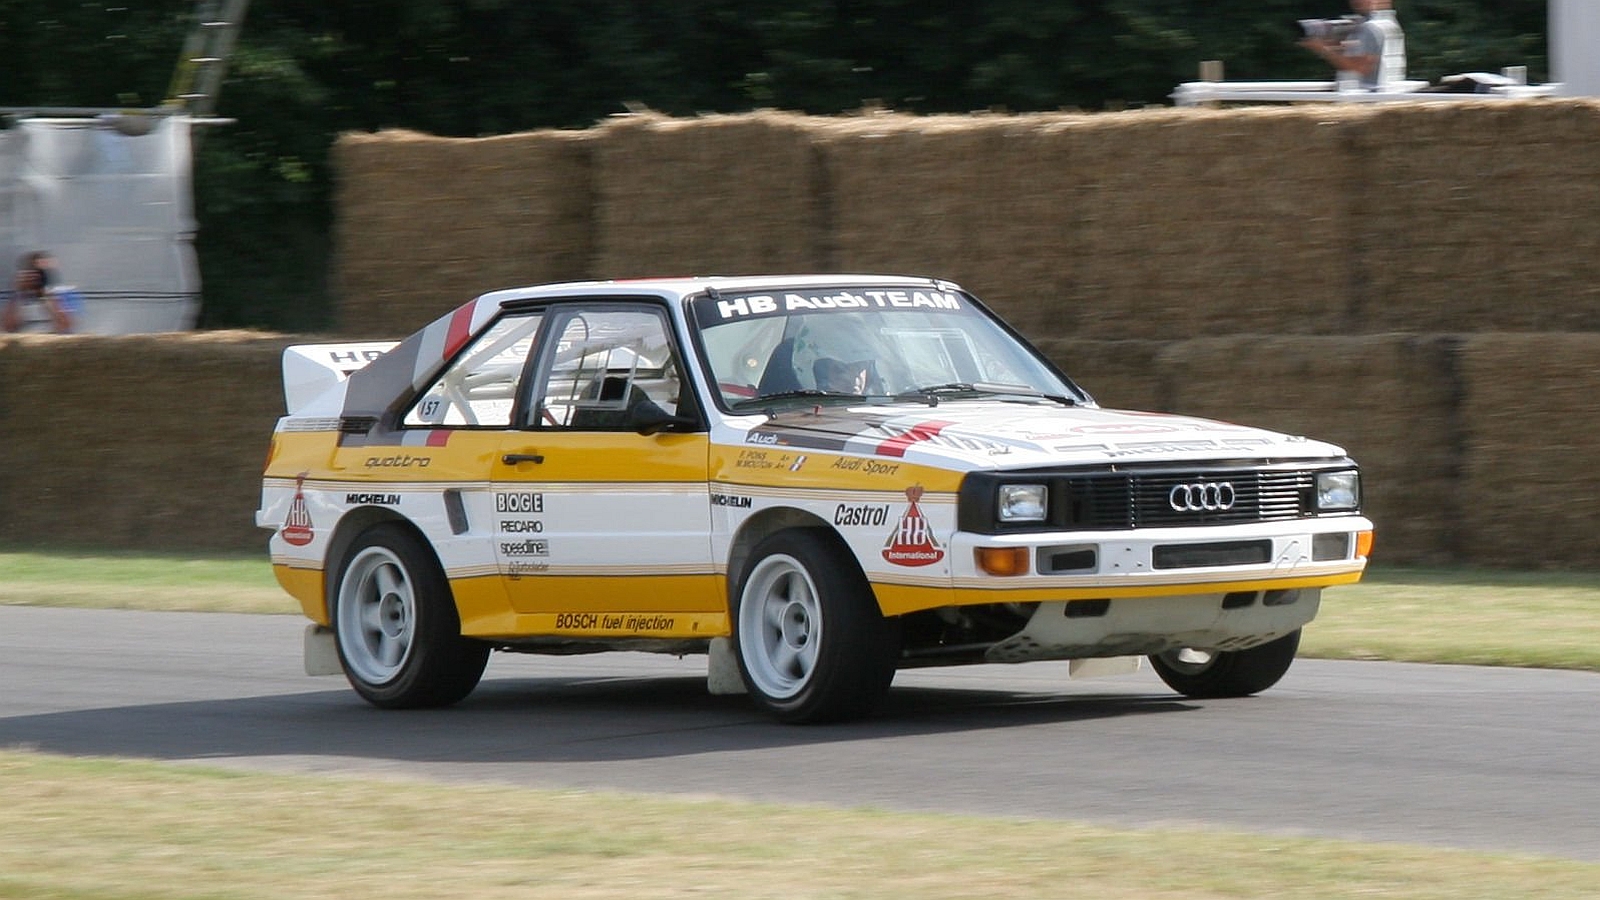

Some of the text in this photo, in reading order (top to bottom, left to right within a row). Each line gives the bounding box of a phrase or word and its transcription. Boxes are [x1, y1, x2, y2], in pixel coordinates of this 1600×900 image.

[718, 291, 960, 319] HB Audi TEAM
[420, 400, 440, 415] 157
[747, 433, 778, 445] Audi
[364, 454, 431, 468] quattro
[832, 456, 899, 476] Audi Sport
[345, 493, 401, 505] MICHELIN
[497, 493, 543, 512] BOGE
[834, 503, 890, 526] Castrol
[500, 520, 543, 533] RECARO
[898, 516, 928, 545] HB
[500, 539, 544, 555] speedline
[889, 551, 938, 560] International
[556, 613, 597, 629] BOSCH
[601, 615, 623, 630] fuel
[625, 615, 674, 632] injection
